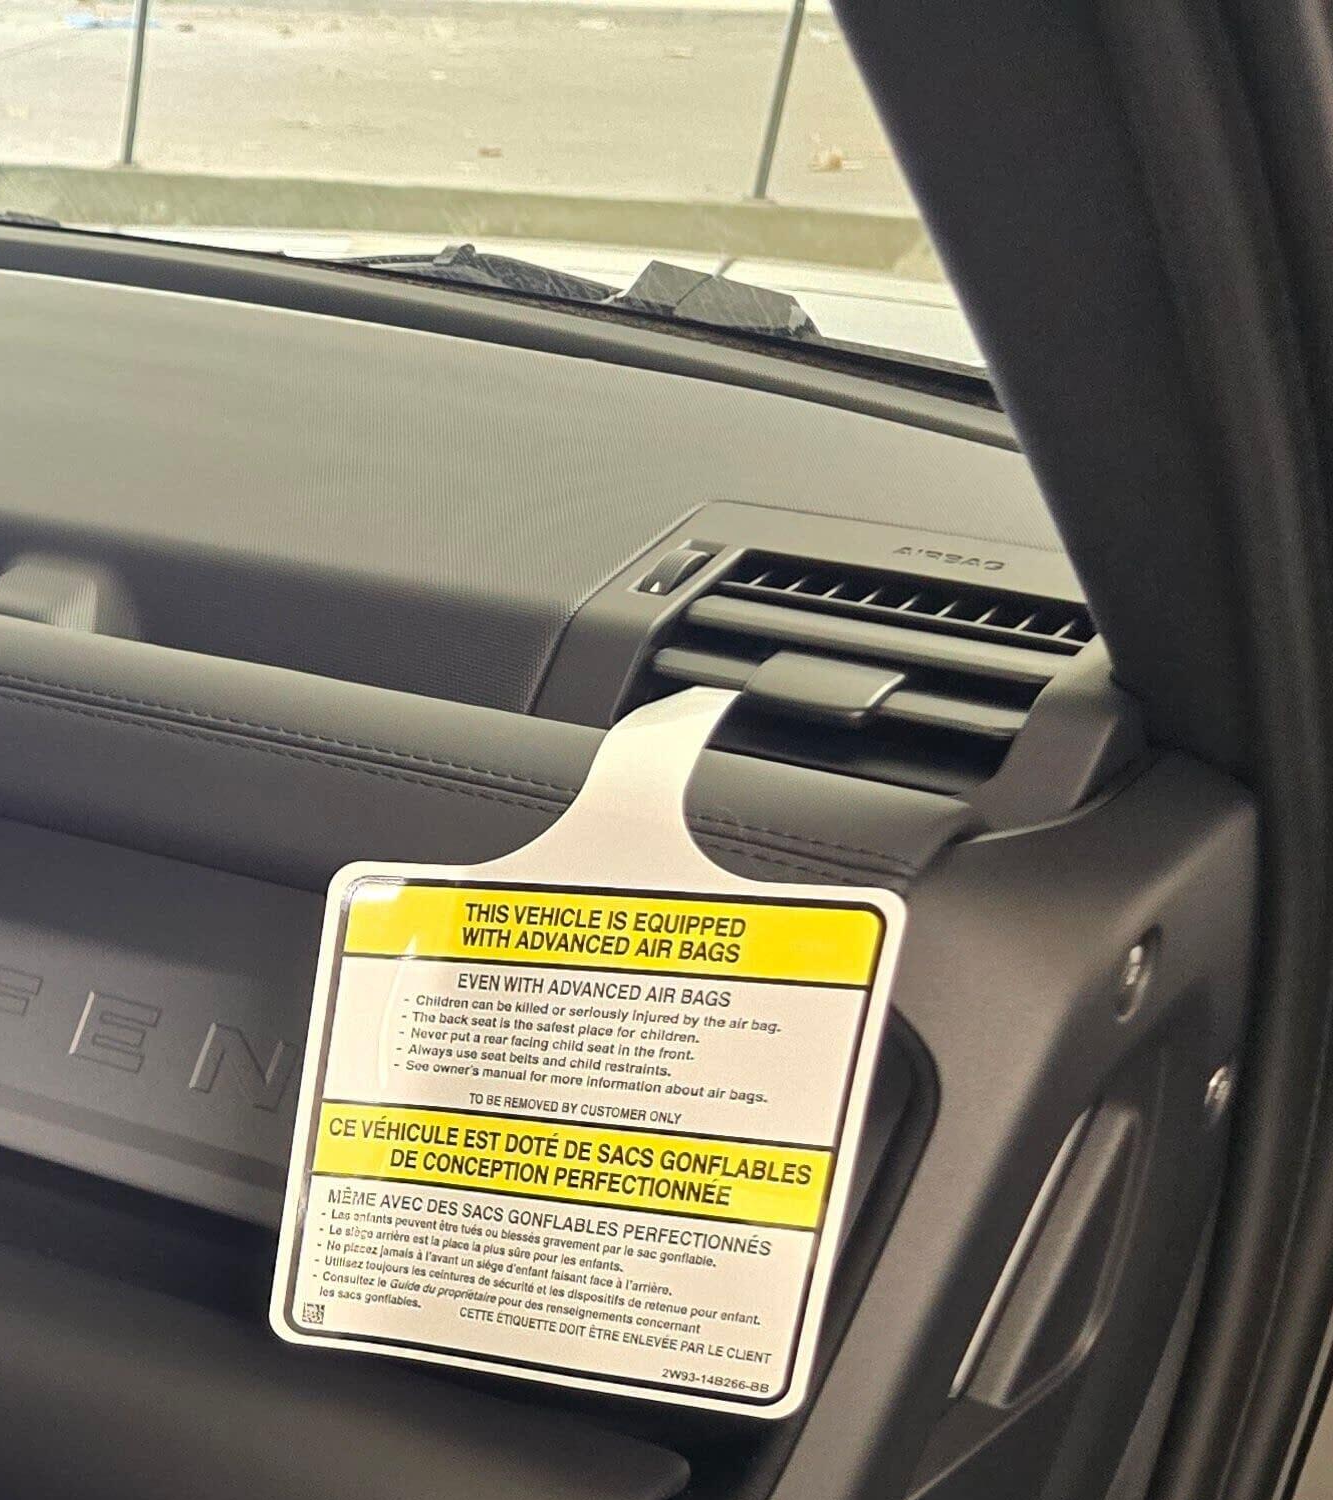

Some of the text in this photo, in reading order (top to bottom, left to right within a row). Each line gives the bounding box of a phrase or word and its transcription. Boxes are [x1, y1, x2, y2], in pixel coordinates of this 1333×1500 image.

[465, 902, 746, 937] THIS VEHICLE IS EQUIPPED
[462, 926, 740, 963] WITH ADVANCED AIR BAGS
[457, 973, 731, 1007] EVEN WITH ADVANCED AIR BAGS
[412, 1011, 699, 1043] The back seat is the safest place for children.
[415, 994, 781, 1034] Children can be killed or seriously injured by the air bag.
[407, 1044, 671, 1077] Always use seat belts and child restraints.
[410, 1027, 694, 1060] Never put a rear facing child seat in the front.
[405, 1059, 767, 1104] See owner's manual for more information about air bags.
[469, 1092, 681, 1124] TO BE REMOVED BY CUSTOMER ONLY
[329, 1115, 811, 1184] CE VÉHICULE EST DOTÉ DE SACS GONFLABLES
[390, 1148, 732, 1206] DE CONCEPTION PERFECTIONNÉE
[327, 1186, 771, 1256] MÊME AVEC DES SACS GONFLABLES PERFECTIONNÉS
[394, 1217, 437, 1230] peuvent
[438, 1219, 458, 1232] être
[460, 1223, 482, 1236] tués
[485, 1228, 498, 1238] ou
[542, 1236, 600, 1252] gravement
[601, 1244, 621, 1255] par
[623, 1244, 634, 1256] le
[636, 1249, 657, 1259] sac
[659, 1251, 716, 1267] gonflable.
[412, 1235, 428, 1245] est
[430, 1235, 439, 1246] la
[441, 1238, 469, 1250] place
[471, 1241, 481, 1252] la
[482, 1244, 505, 1256] plus
[507, 1246, 530, 1259] sûre
[532, 1251, 558, 1263] pour
[560, 1253, 576, 1265] les
[578, 1257, 623, 1272] enfants.
[326, 1239, 341, 1251] Ne
[379, 1244, 413, 1259] jamais
[416, 1249, 422, 1260] à
[425, 1251, 458, 1265] l'avant
[460, 1257, 473, 1267] un
[506, 1263, 548, 1279] d'enfant
[550, 1268, 587, 1284] faisant
[589, 1274, 613, 1287] face
[615, 1279, 622, 1289] à
[319, 1285, 421, 1308] les sacs gonflables.
[365, 1260, 408, 1274] toujours
[411, 1265, 426, 1276] les
[428, 1269, 475, 1284] ceintures
[477, 1275, 490, 1286] de
[536, 1285, 546, 1295] et
[548, 1285, 565, 1297] les
[567, 1289, 625, 1306] dispositifs
[627, 1297, 641, 1308] de
[644, 1301, 687, 1314] retenue
[689, 1307, 718, 1319] pour
[720, 1311, 760, 1325] enfant.
[377, 1276, 386, 1287] le
[389, 1278, 420, 1291] Guide
[422, 1283, 436, 1294] du
[497, 1296, 522, 1307] pour
[524, 1298, 543, 1310] des
[545, 1303, 633, 1324] renseignements
[635, 1317, 701, 1334] concernant
[459, 1306, 494, 1322] CETTE
[558, 1322, 586, 1337] DOIT
[622, 1332, 678, 1350] ENLEVÉE
[679, 1340, 704, 1354] PAR
[707, 1344, 723, 1357] LE
[726, 1347, 772, 1363] CLIENT
